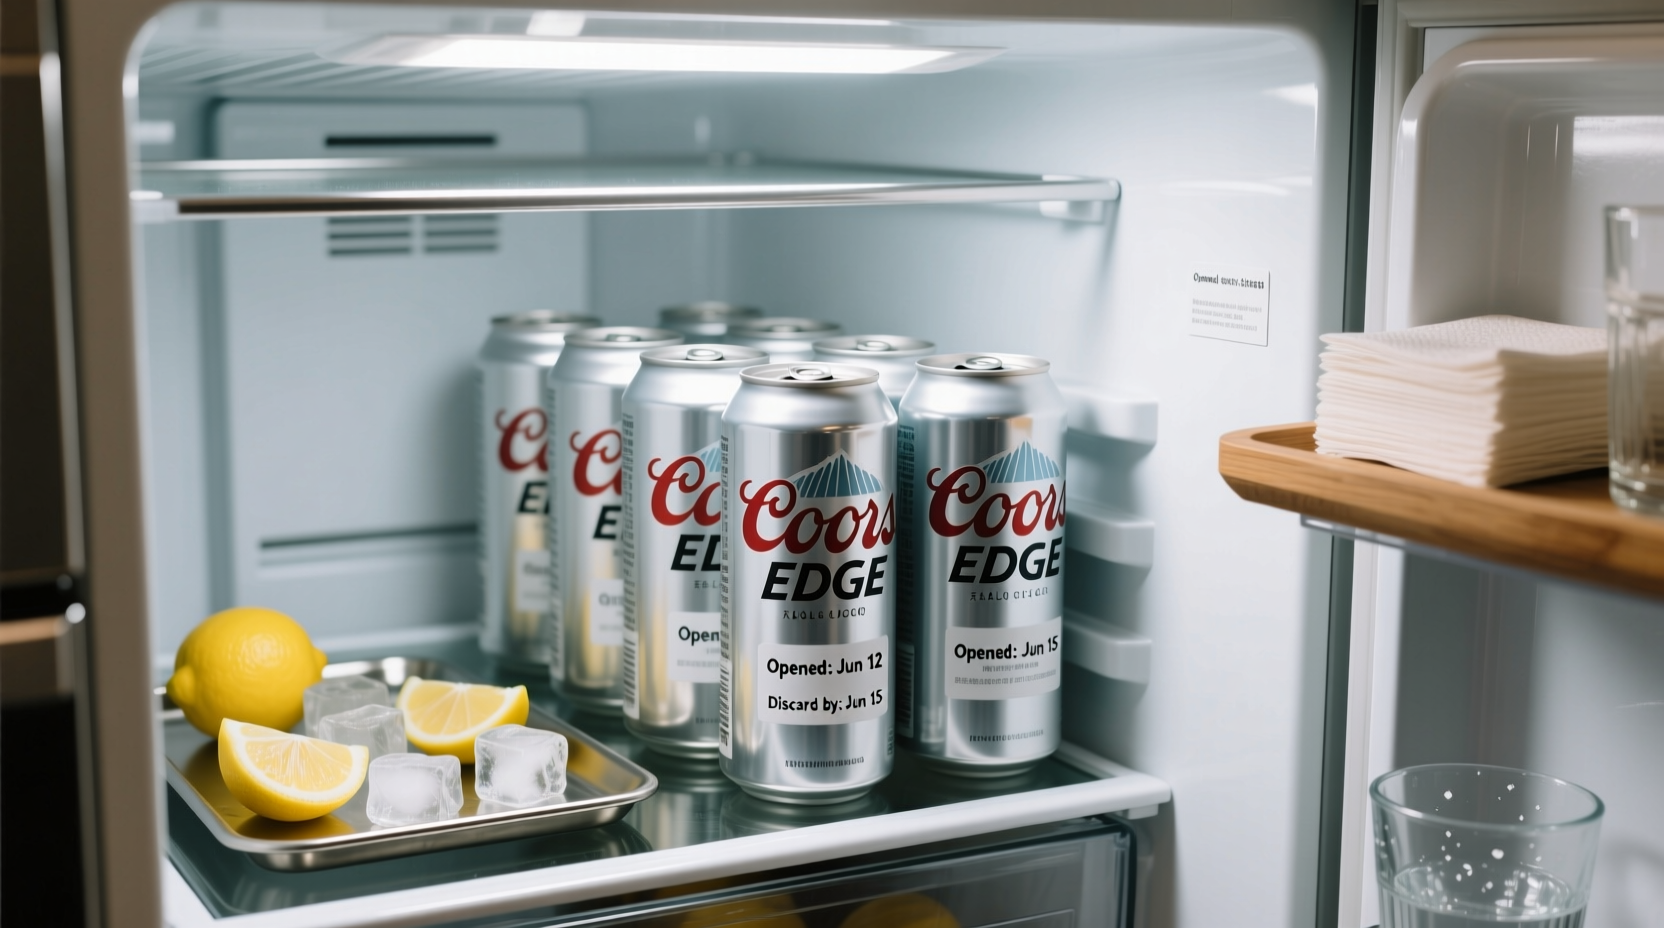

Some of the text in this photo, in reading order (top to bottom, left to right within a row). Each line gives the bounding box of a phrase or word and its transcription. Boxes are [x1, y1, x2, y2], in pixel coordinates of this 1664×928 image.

[739, 479, 896, 554] Coors
[926, 465, 1066, 538] Coors
[761, 555, 888, 601] EDGE
[948, 537, 1063, 583] EDGE
[678, 626, 720, 646] Open
[954, 635, 1059, 663] Opened: Jun 15
[766, 652, 883, 679] Opened: Jun 12
[768, 689, 883, 714] Discard by: Jun 15
